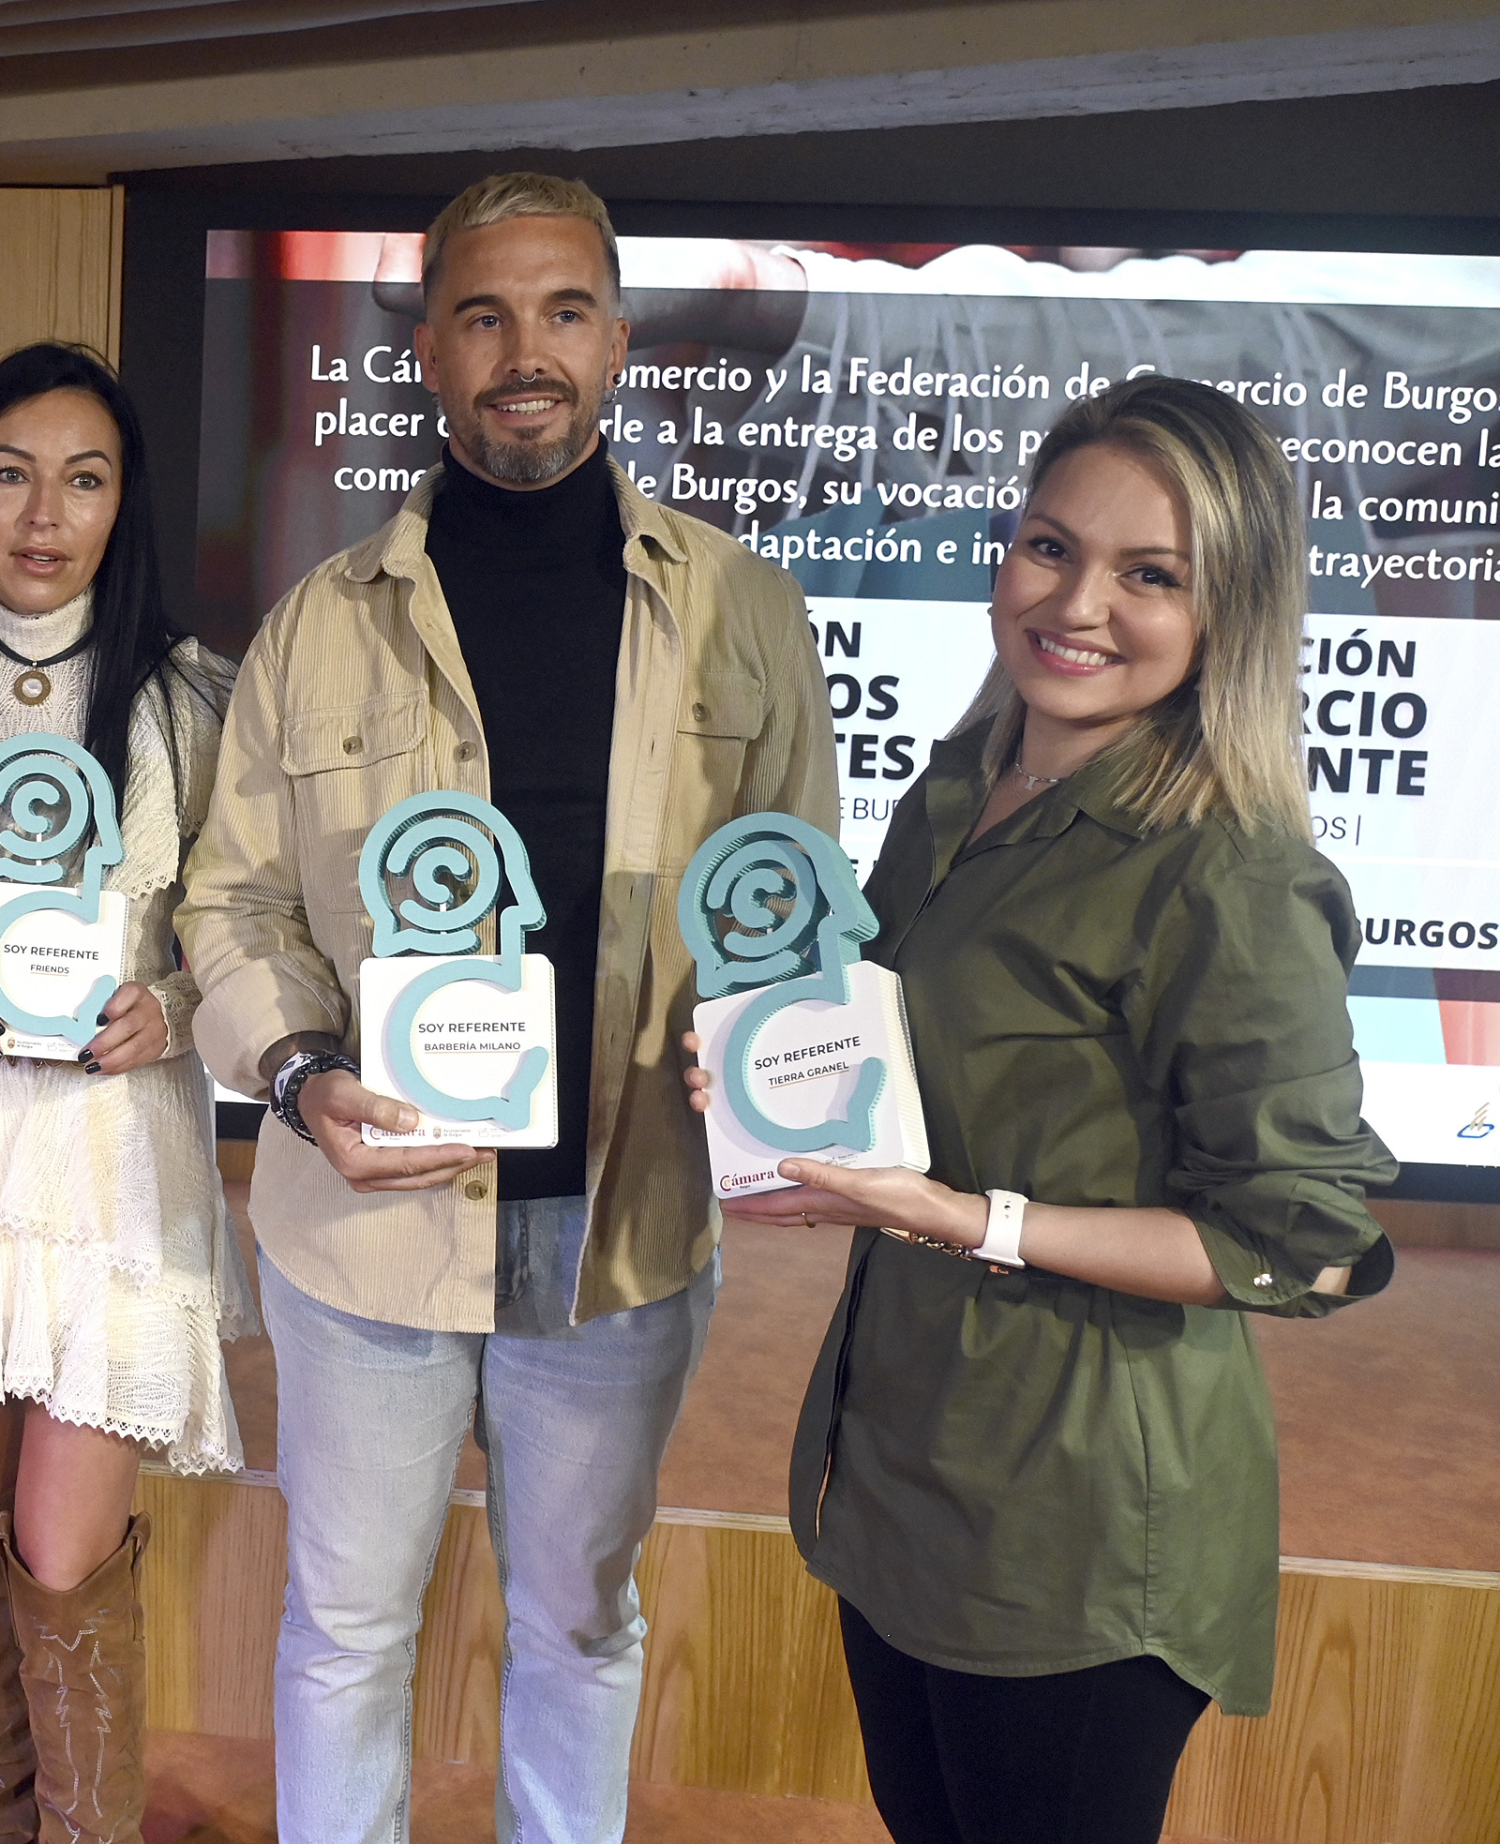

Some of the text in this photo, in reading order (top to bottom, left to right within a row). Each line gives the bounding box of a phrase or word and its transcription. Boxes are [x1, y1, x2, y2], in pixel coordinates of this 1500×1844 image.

[310, 344, 349, 382] La
[363, 346, 422, 383] Cá
[765, 368, 787, 403] y
[801, 354, 832, 394] la
[849, 357, 1050, 399] Federación
[1065, 361, 1110, 399] de
[1322, 368, 1368, 409] de
[1383, 371, 1500, 424] Burgo
[314, 397, 424, 446] placer
[600, 405, 644, 443] rle
[657, 419, 678, 444] a
[693, 406, 724, 445] la
[738, 417, 878, 462] entrega
[893, 412, 939, 451] de
[953, 413, 1004, 454] los
[334, 467, 427, 492] come
[672, 463, 807, 515] Burgos,
[822, 480, 862, 505] su
[877, 475, 1028, 511] vocació
[1312, 480, 1343, 520] la
[1358, 491, 1500, 525] comuni
[737, 520, 922, 569] daptación
[936, 539, 958, 564] e
[826, 673, 900, 721] OS
[1308, 746, 1428, 796] NTE
[1312, 815, 1347, 839] OS
[1365, 917, 1499, 950] URGOS
[4, 944, 99, 961] SOY REFERENTE
[30, 964, 70, 974] FRIENDS
[418, 1022, 526, 1033] SOY REFERENTE
[424, 1041, 521, 1051] BARBERÍA MILANO
[754, 1036, 861, 1070] SOY REFERENTE
[768, 1061, 850, 1086] TIERRA GRANEL
